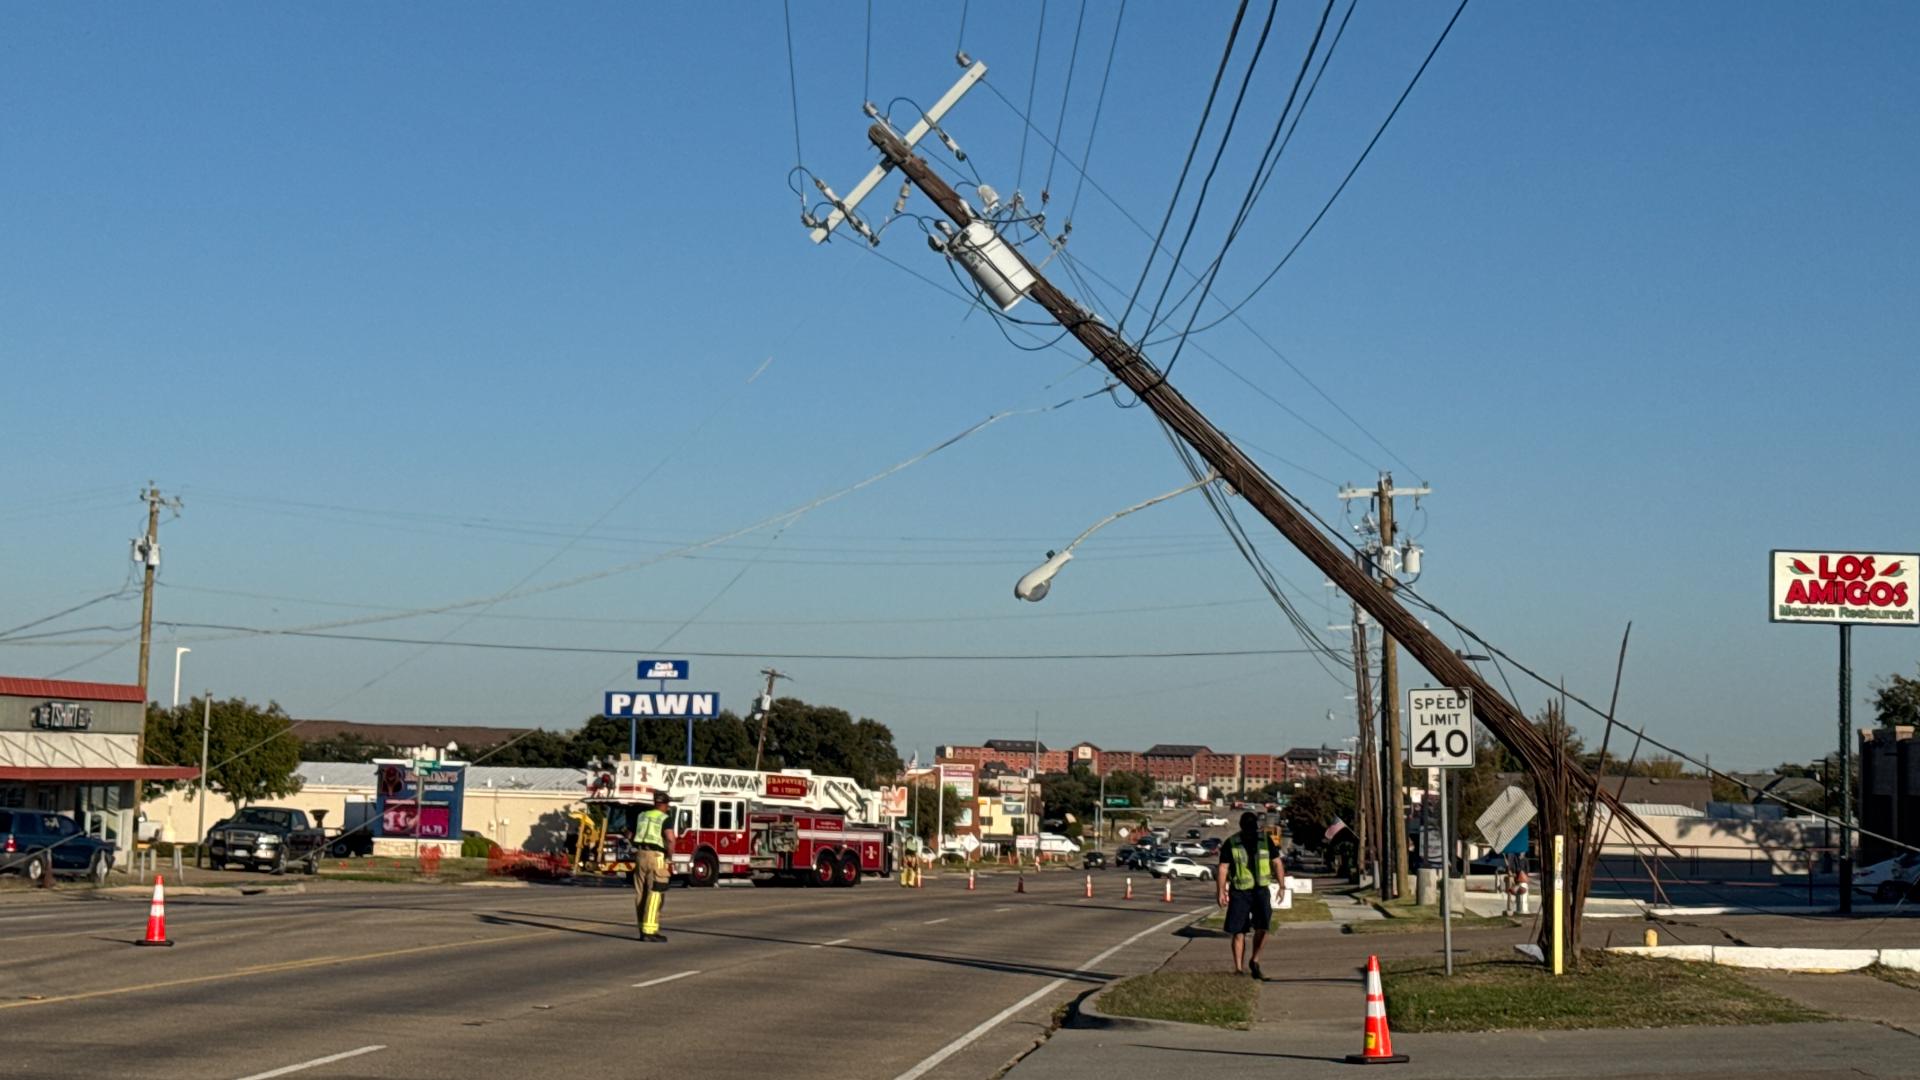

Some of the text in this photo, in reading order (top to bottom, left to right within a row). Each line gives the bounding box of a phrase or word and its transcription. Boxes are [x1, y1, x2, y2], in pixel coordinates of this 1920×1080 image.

[1819, 555, 1876, 581] LOS
[1785, 579, 1908, 607] AMIGOS
[1779, 605, 1914, 620] Mexican Restaurant
[611, 694, 713, 715] PAWN
[1414, 697, 1467, 710] SPEED
[1420, 713, 1461, 726] LIMIT
[1415, 729, 1469, 758] 40
